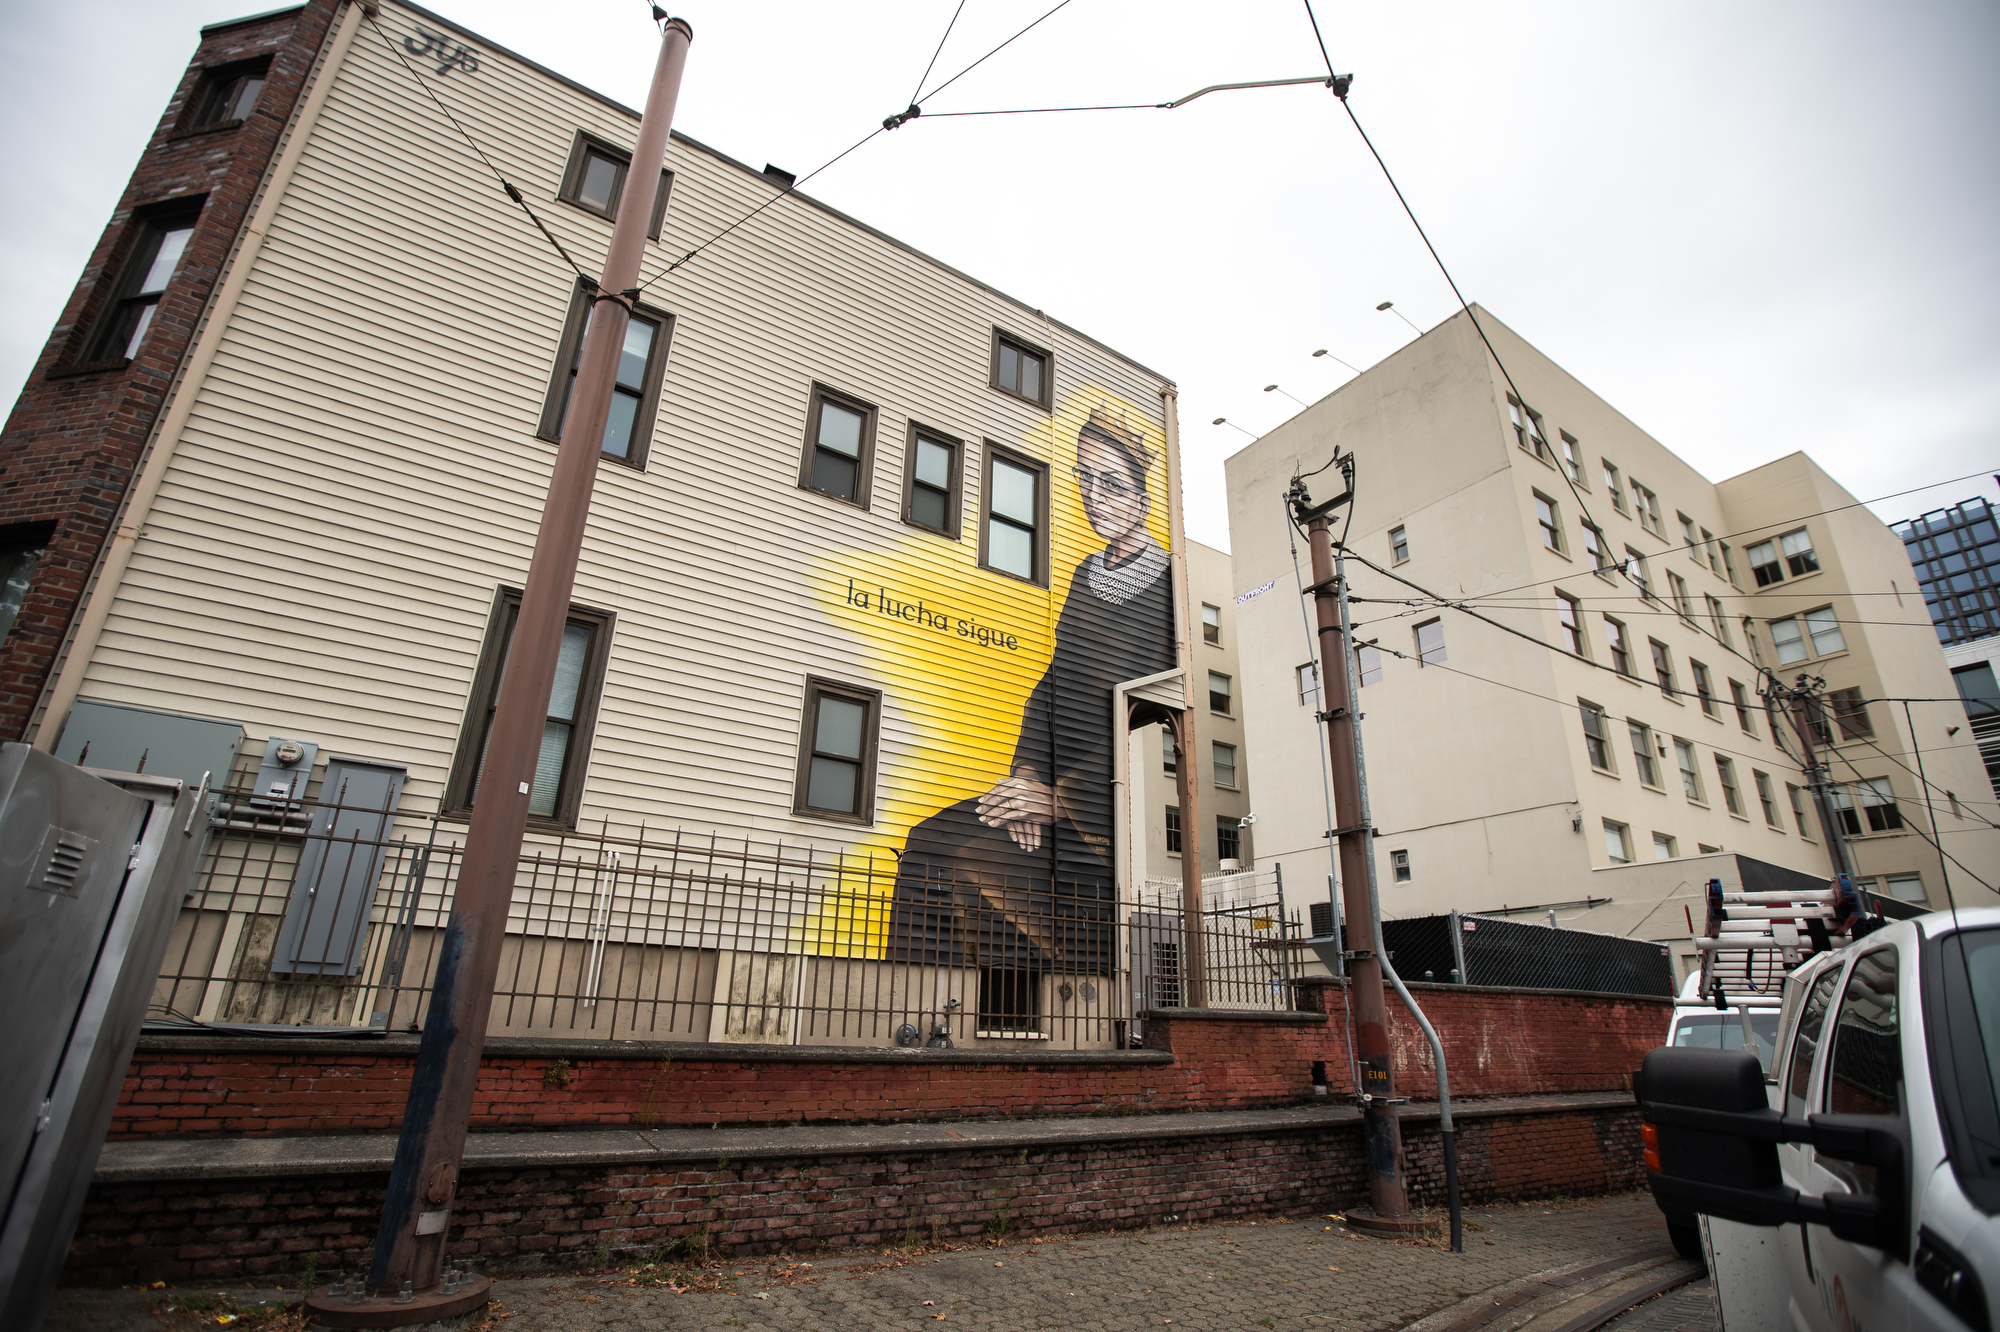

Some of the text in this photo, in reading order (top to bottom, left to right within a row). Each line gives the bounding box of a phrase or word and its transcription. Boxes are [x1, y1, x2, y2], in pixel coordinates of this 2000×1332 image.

[1237, 581, 1275, 603] OUTFRONT
[847, 579, 1018, 650] la lucha sigue
[1368, 1070, 1387, 1079] E101
